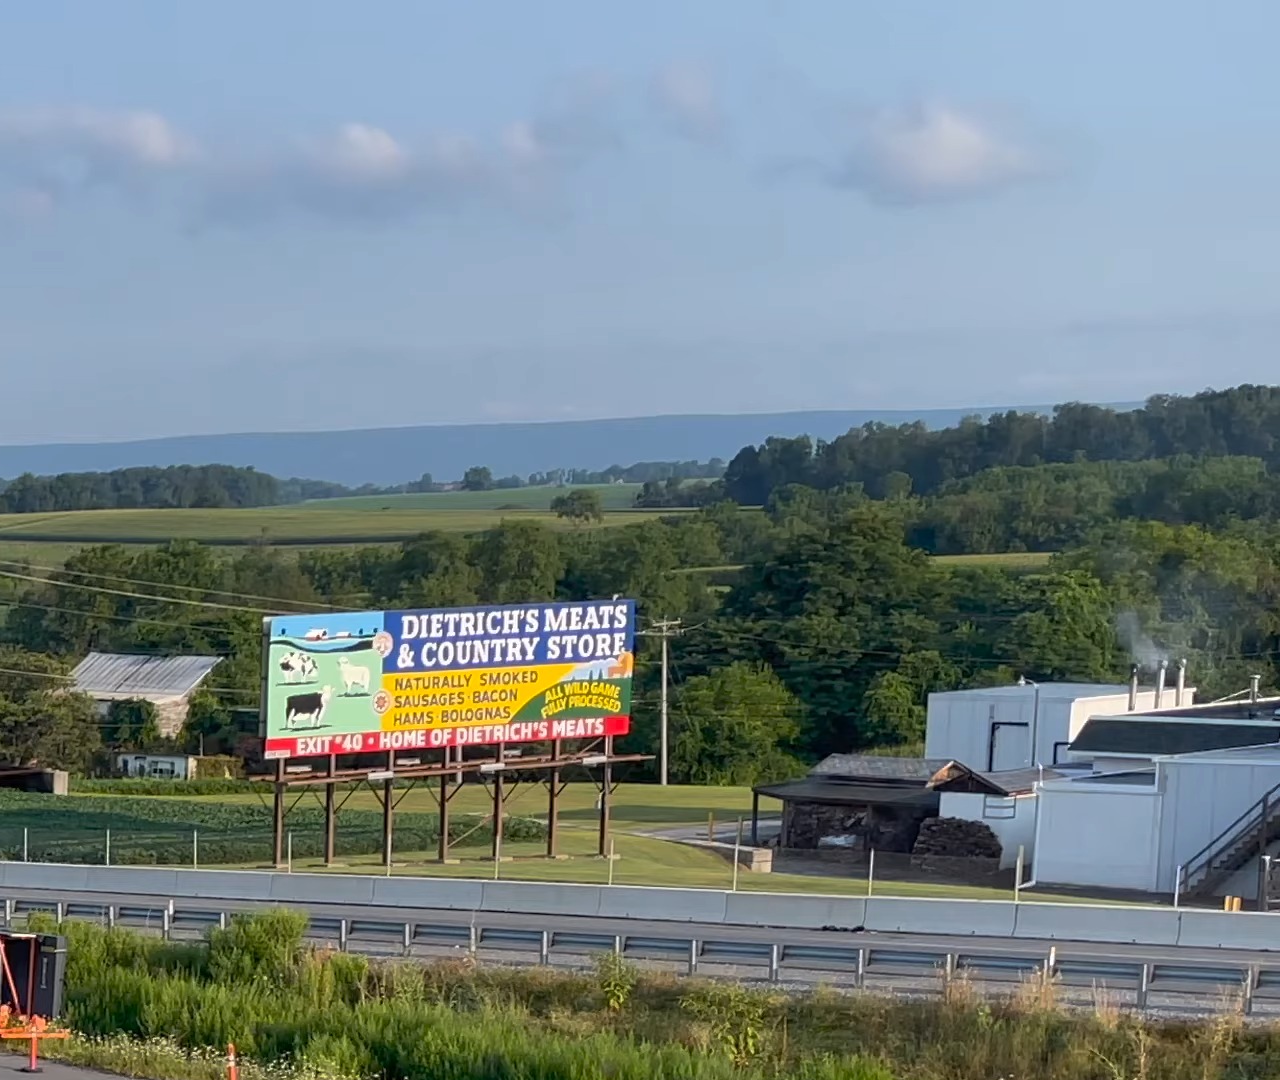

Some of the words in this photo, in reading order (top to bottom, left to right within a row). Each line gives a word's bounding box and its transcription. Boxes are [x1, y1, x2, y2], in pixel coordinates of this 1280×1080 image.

[401, 609, 540, 639] DIETRICH'S
[543, 604, 627, 632] MEATS
[397, 643, 415, 668] &
[421, 637, 540, 667] COUNTRY
[546, 632, 626, 660] STORE
[394, 674, 472, 691] NATURALLY
[479, 671, 538, 686] SMOKED
[394, 691, 465, 708] SAUSAGES
[472, 688, 518, 704] BACON
[545, 686, 563, 704] ALL
[564, 682, 589, 695] WILD
[591, 682, 621, 698] GAME
[393, 711, 434, 726] HAMS
[441, 706, 511, 723] BOLOGNAS
[541, 697, 567, 719] FULLY
[568, 695, 621, 713] PROCESSED
[296, 737, 333, 755] EXIT
[379, 730, 426, 748] HOME
[431, 729, 452, 745] OF
[456, 721, 548, 744] DIETRICH'S
[552, 718, 605, 738] MEATS
